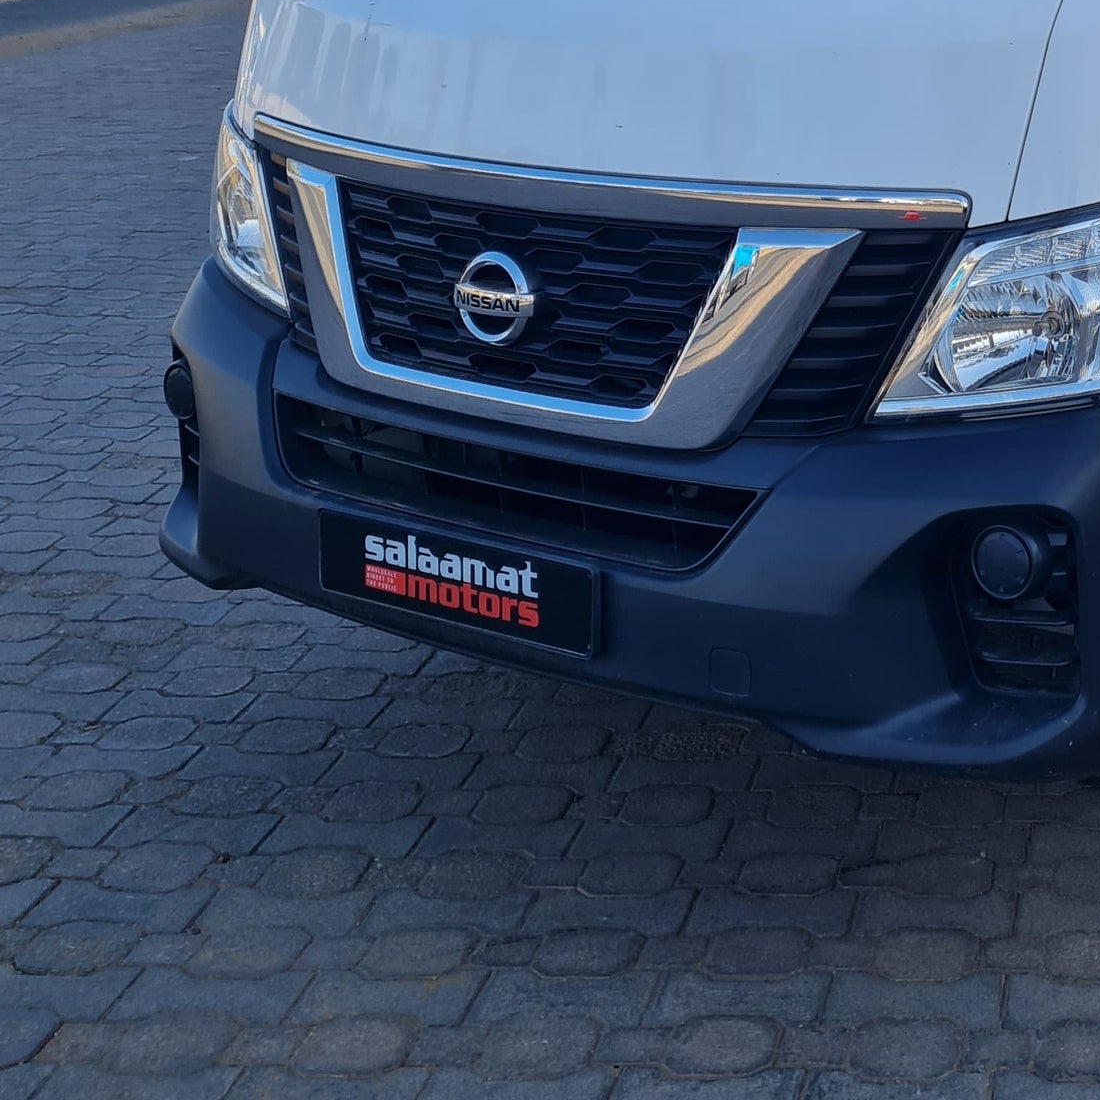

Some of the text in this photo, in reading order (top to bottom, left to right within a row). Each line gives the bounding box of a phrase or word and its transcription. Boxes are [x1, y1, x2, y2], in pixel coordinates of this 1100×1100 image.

[456, 289, 520, 313] NISSAN
[364, 534, 539, 599] salaamat
[407, 573, 539, 628] motors
